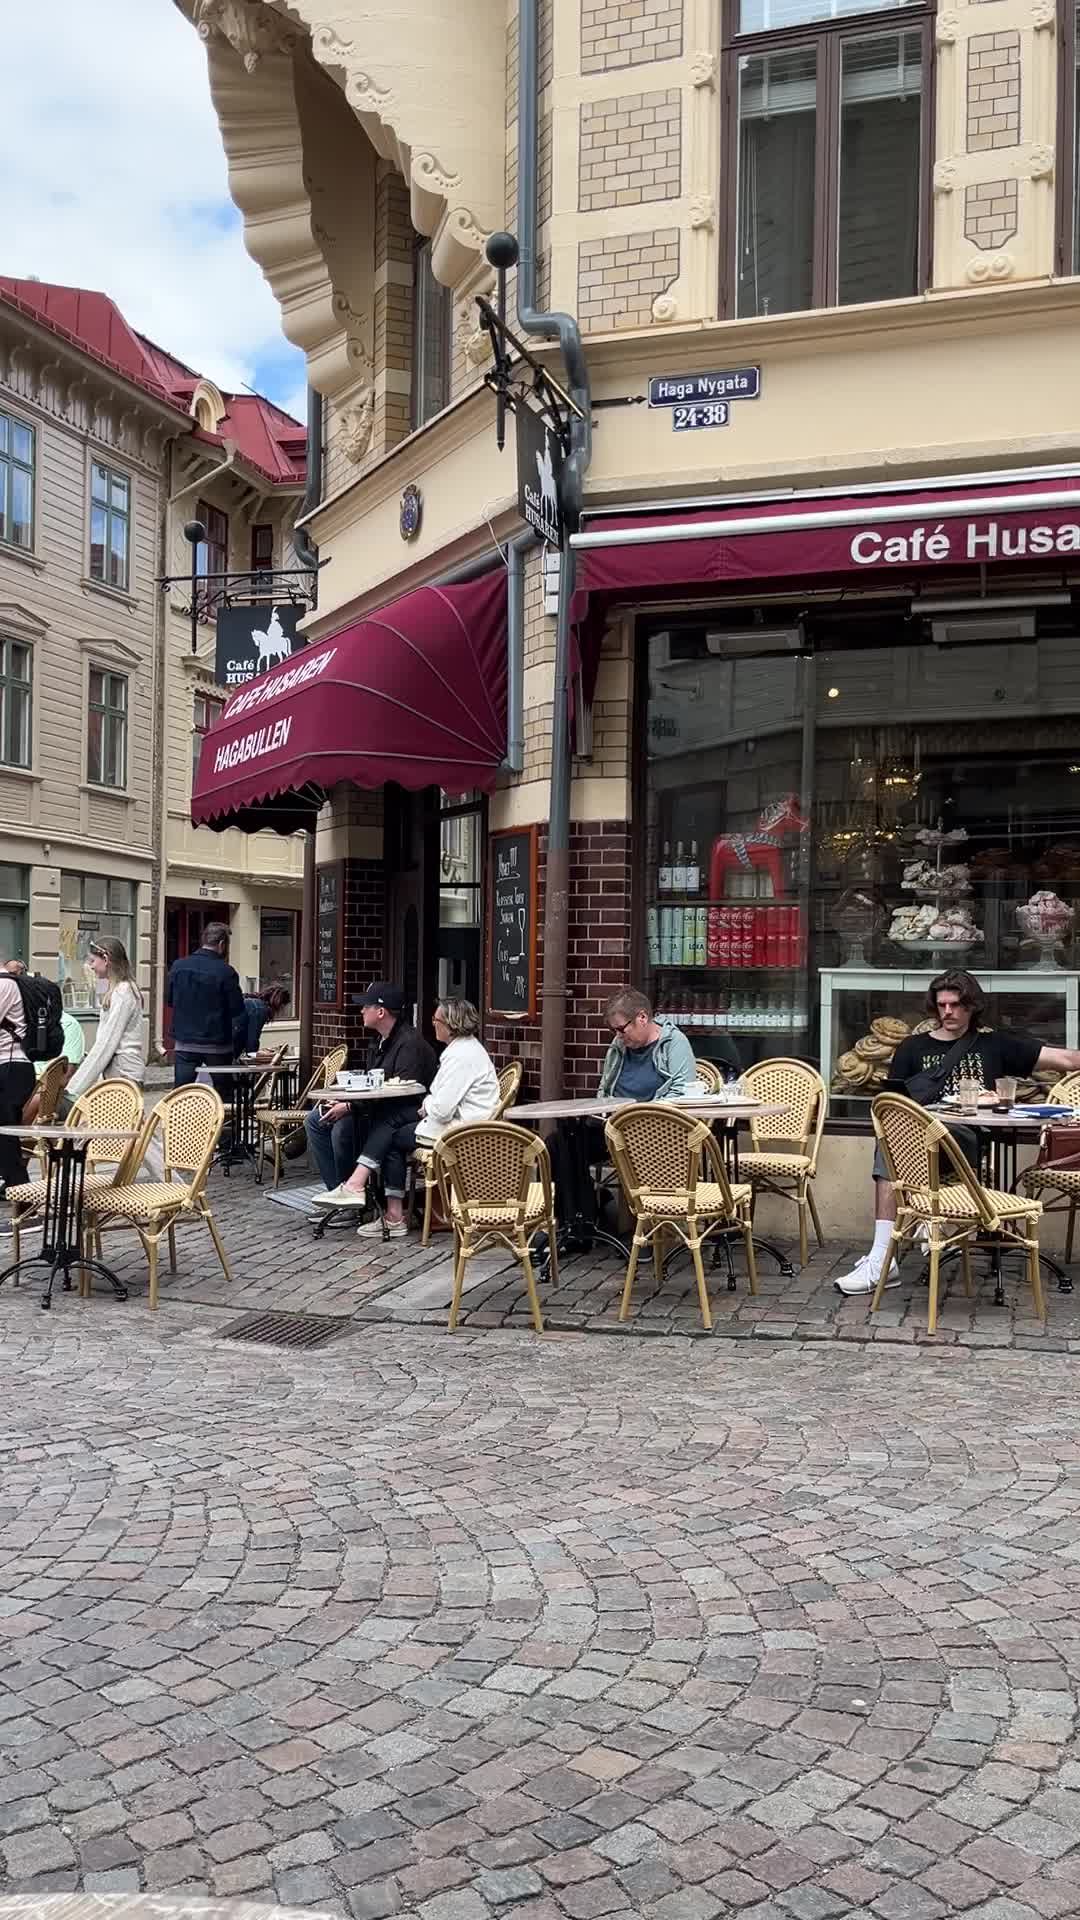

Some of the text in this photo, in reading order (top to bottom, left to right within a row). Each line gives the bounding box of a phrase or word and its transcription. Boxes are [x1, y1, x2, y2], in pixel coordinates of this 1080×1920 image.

[659, 374, 748, 399] Haga Nygata
[675, 404, 726, 427] 24-38
[524, 484, 541, 511] Café
[525, 503, 559, 545] HUSAREN
[850, 522, 1080, 564] Café Husa
[226, 660, 255, 671] Café
[224, 647, 338, 720] CAFÉ HUSAREN
[213, 716, 292, 774] HAGABULLEN
